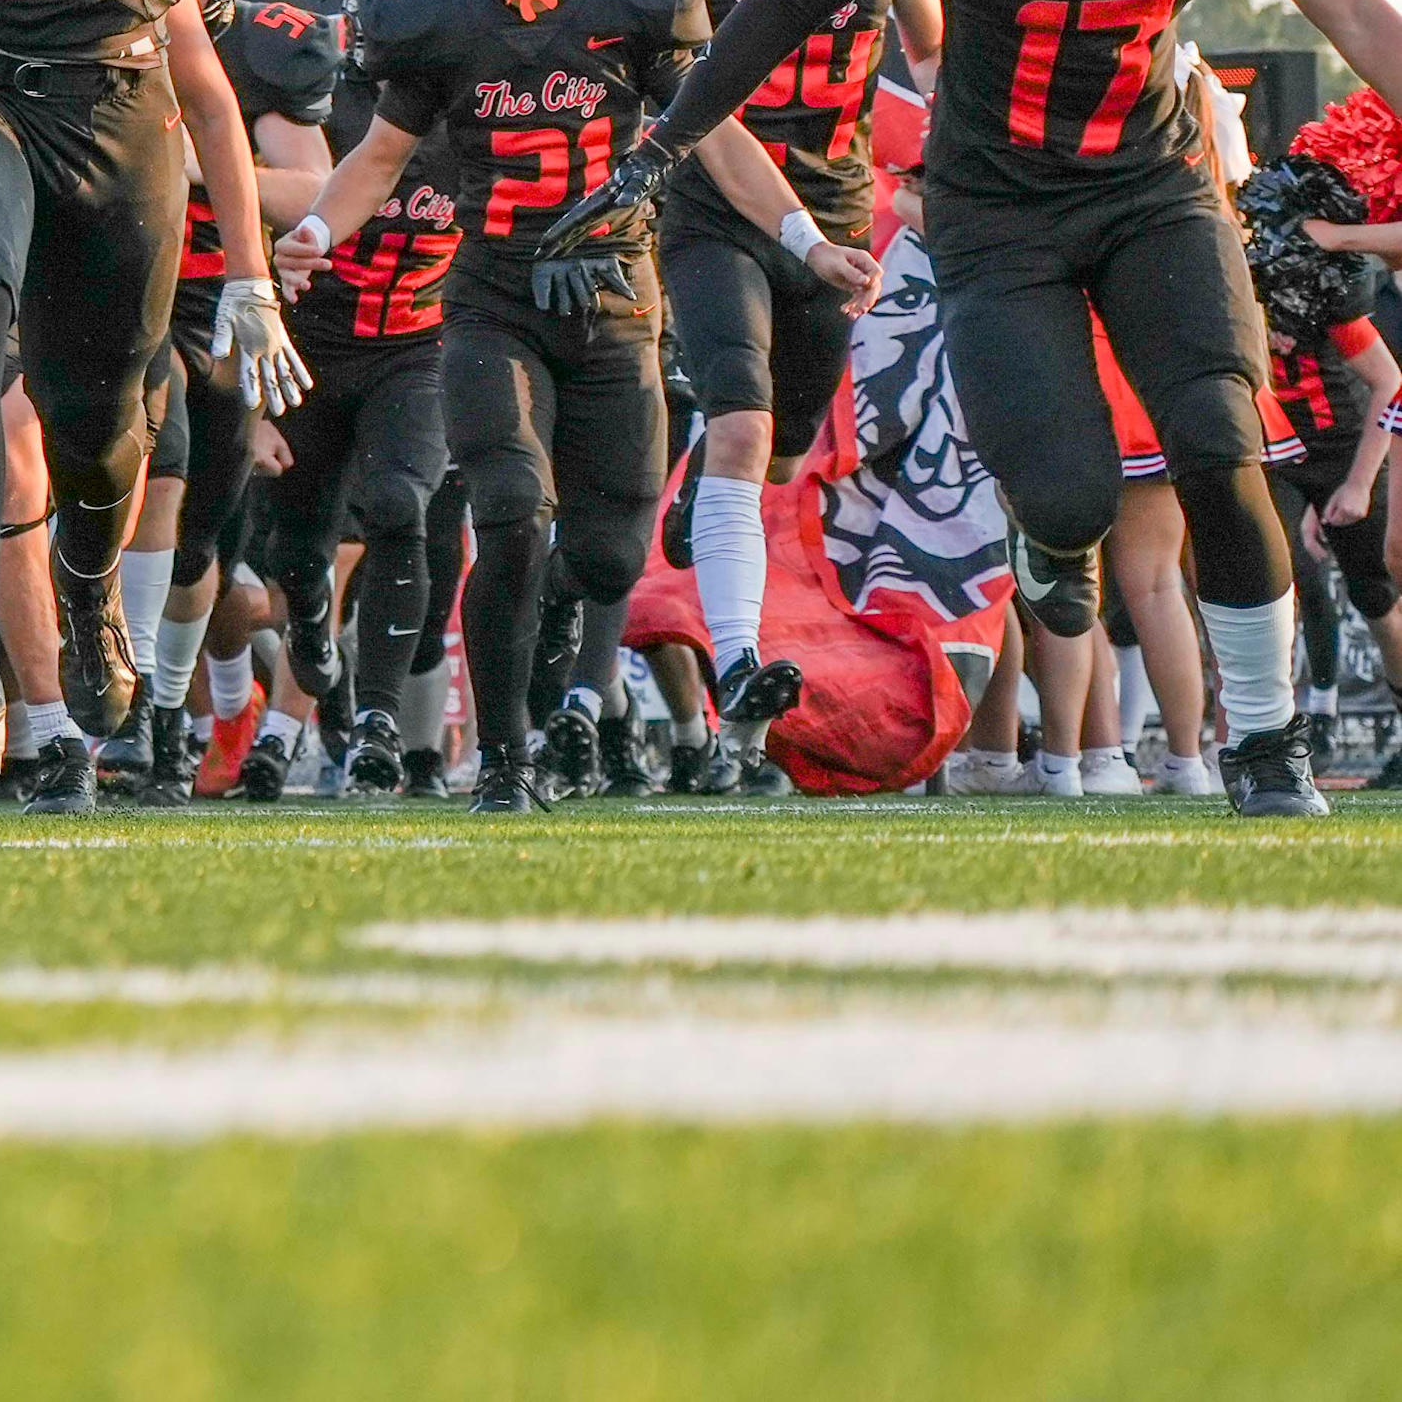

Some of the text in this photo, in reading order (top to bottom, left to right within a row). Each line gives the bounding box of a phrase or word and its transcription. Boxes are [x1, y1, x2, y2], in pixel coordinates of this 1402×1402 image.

[474, 69, 607, 119] The City
[483, 117, 613, 236] 21
[406, 185, 456, 231] City
